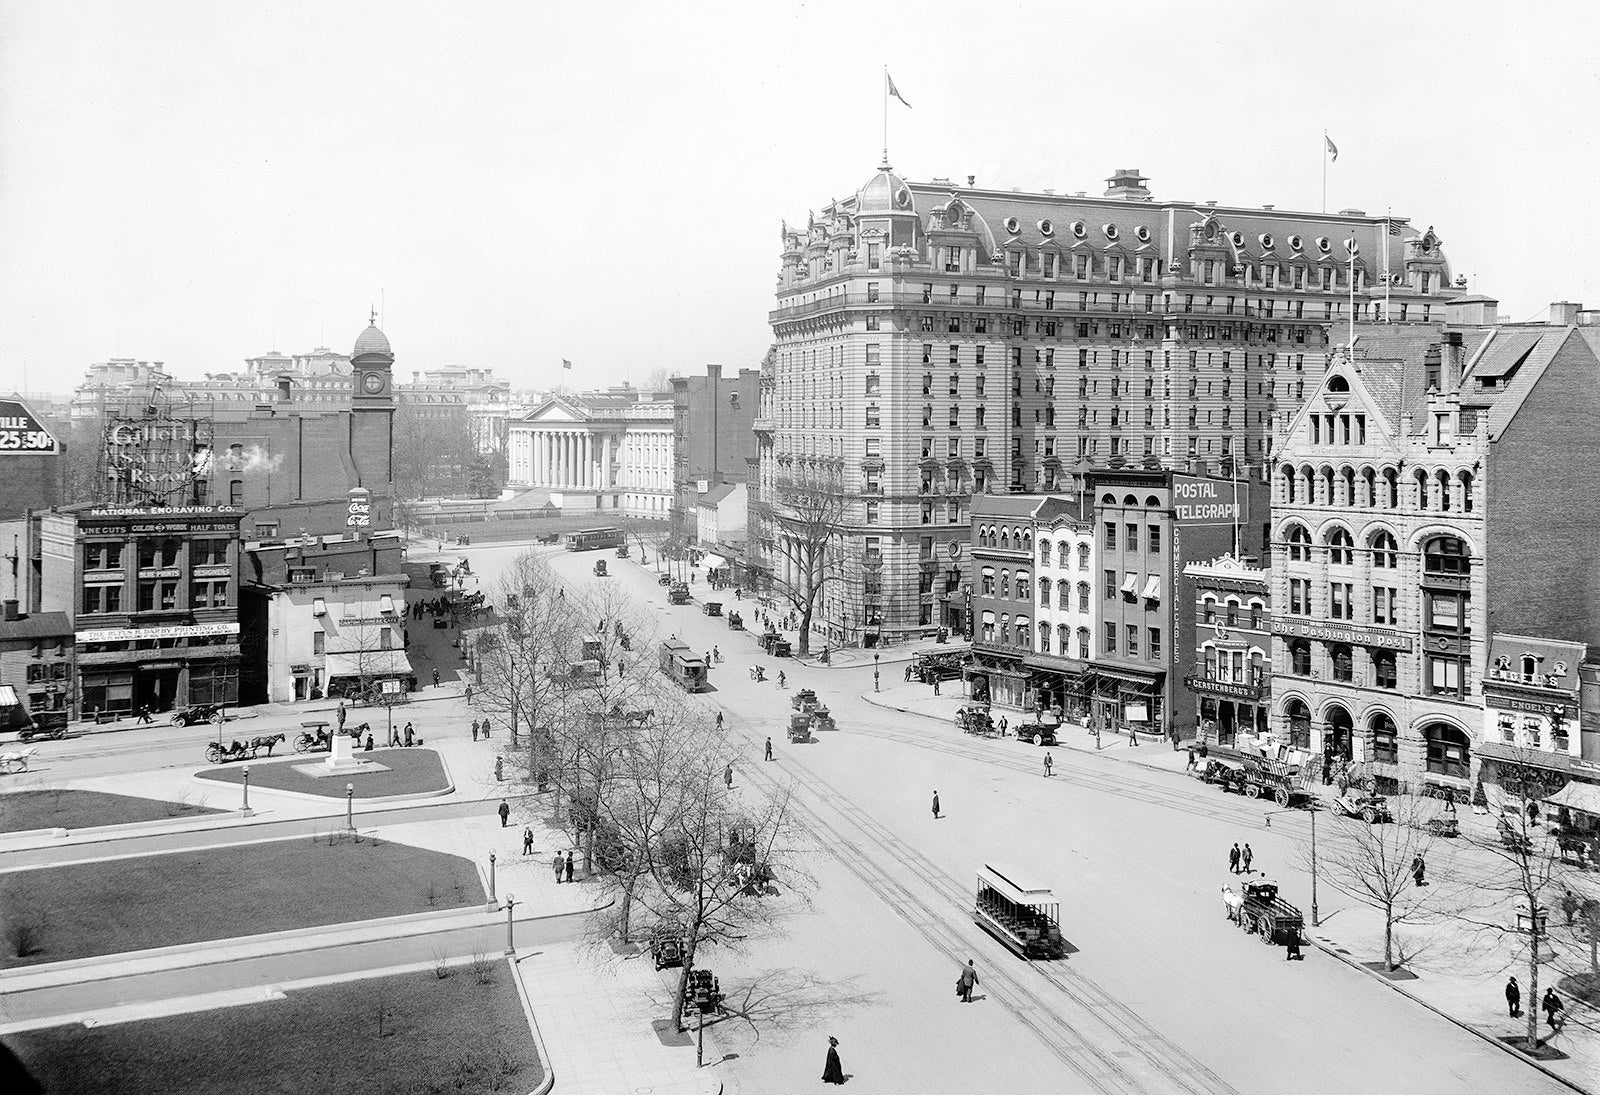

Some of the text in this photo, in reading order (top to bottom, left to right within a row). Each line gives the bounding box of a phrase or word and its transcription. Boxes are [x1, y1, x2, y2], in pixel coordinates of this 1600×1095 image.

[1174, 483, 1218, 499] POSTAL
[91, 508, 147, 516] NATIONAL
[150, 506, 213, 515] ENGRAVING
[349, 503, 370, 513] Coca
[1174, 503, 1240, 520] TELEGRAPH
[347, 514, 370, 526] Cola
[102, 526, 127, 534] CUTS
[174, 625, 213, 633] PRINTING
[1274, 622, 1406, 648] The Washington Post
[1193, 680, 1248, 695] GERSTENBERG'S
[1511, 701, 1551, 713] ENGEL'S
